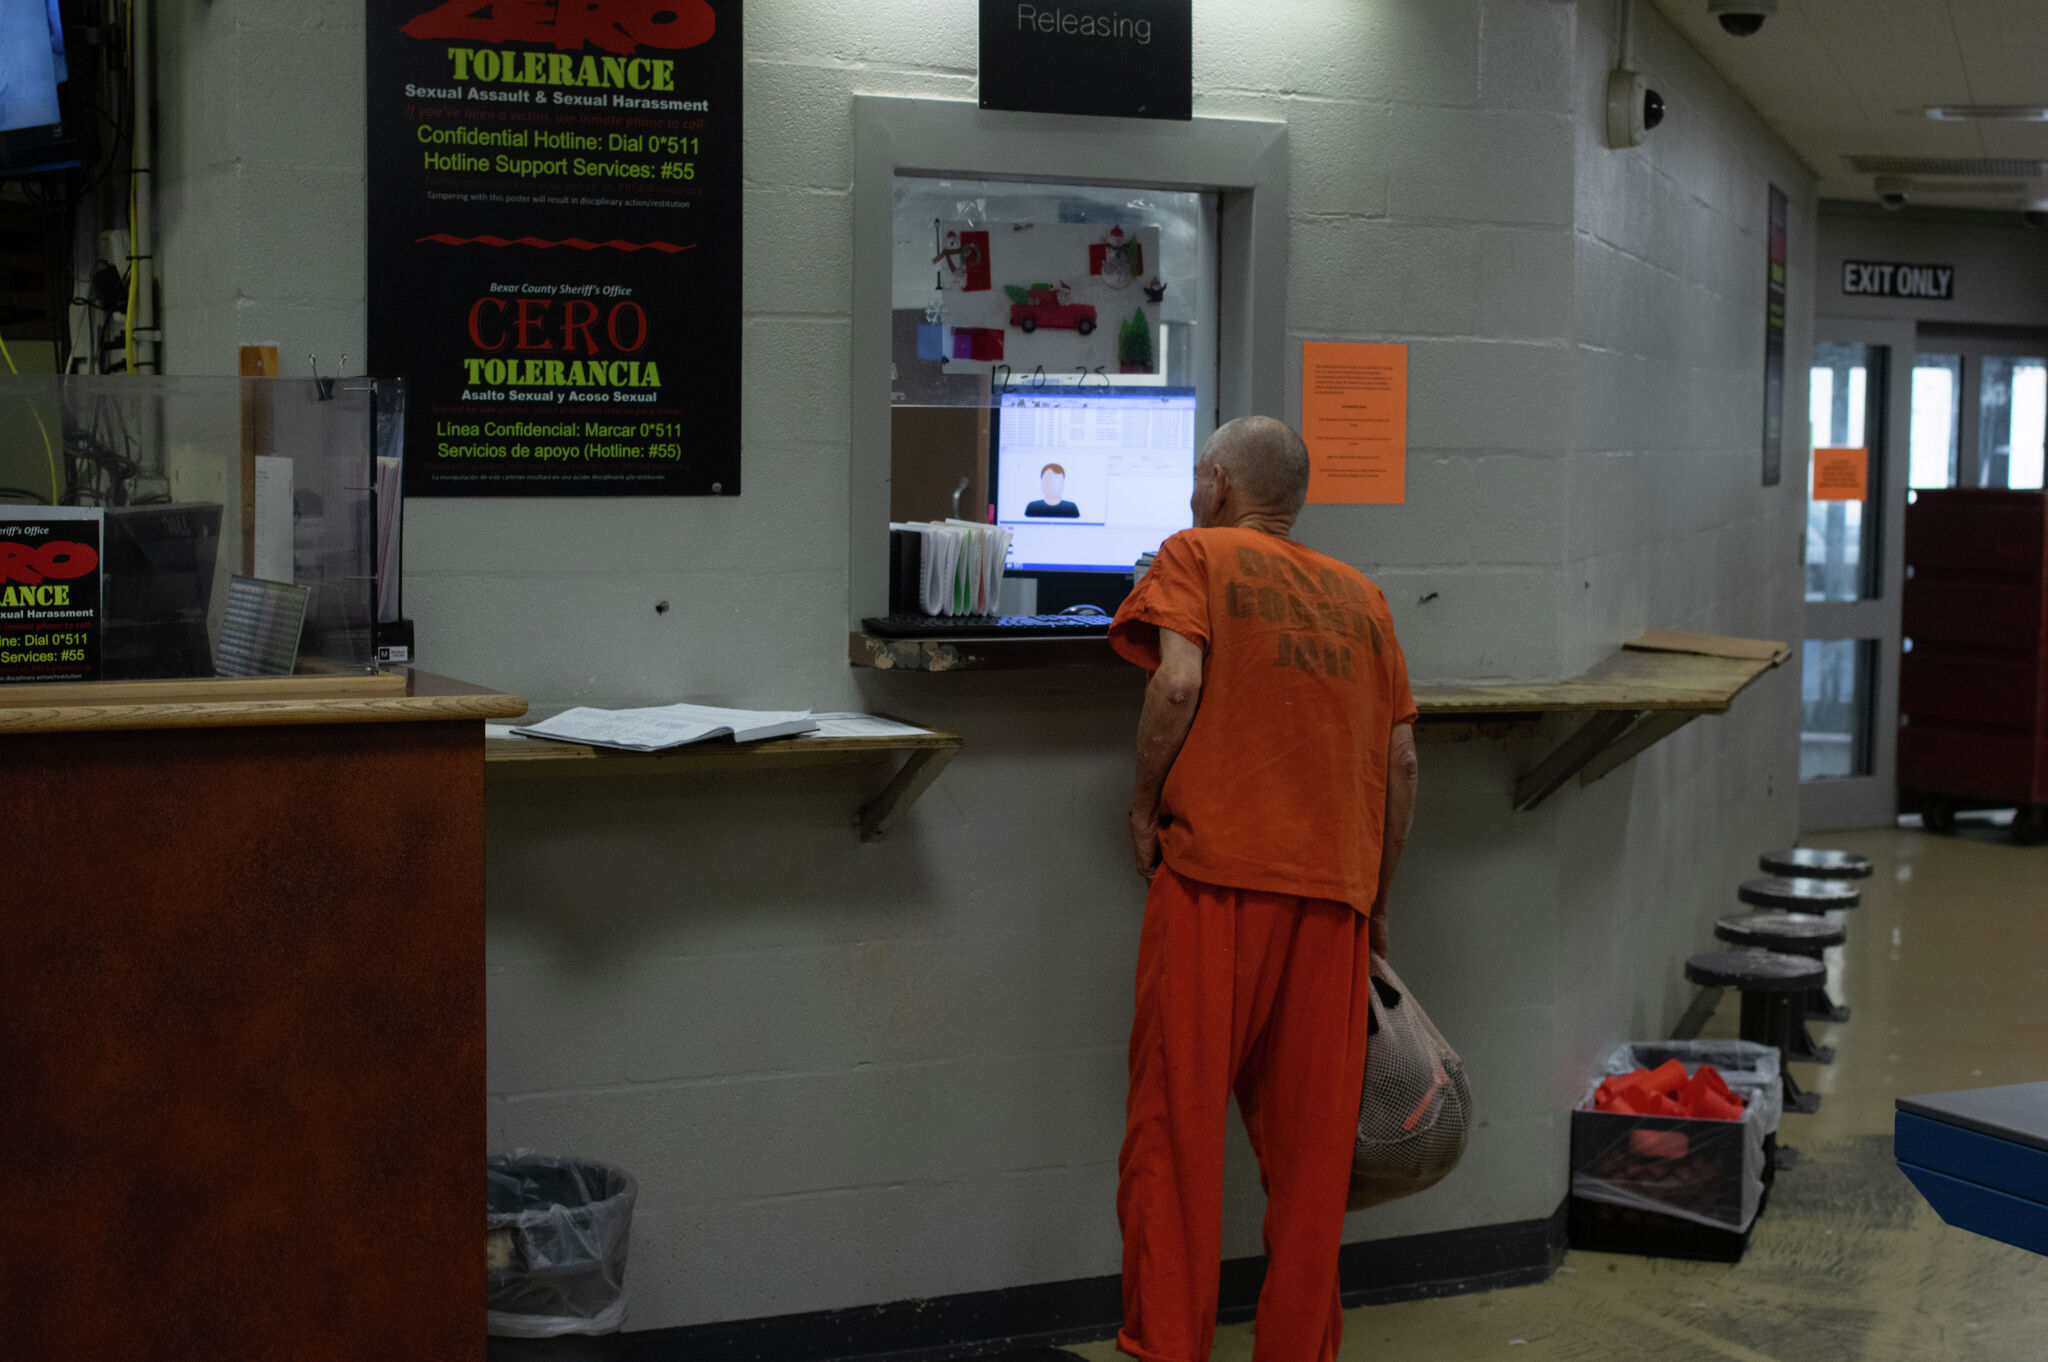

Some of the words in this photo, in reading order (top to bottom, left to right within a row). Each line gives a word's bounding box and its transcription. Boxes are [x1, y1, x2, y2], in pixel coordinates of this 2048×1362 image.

[398, 0, 717, 54] ZERO
[1018, 4, 1151, 44] Releasing
[448, 47, 675, 91] TOLERANCE
[404, 83, 462, 99] Sexual
[467, 87, 530, 103] Assault
[535, 90, 548, 103] &
[552, 91, 608, 107] Sexual
[612, 95, 710, 112] Harassment
[417, 124, 528, 147] Confidential
[534, 129, 603, 151] Hotline:
[608, 133, 644, 152] Dial
[424, 151, 490, 171] Hotline
[495, 154, 568, 178] Support
[573, 157, 656, 179] Services:
[660, 161, 696, 181] #55
[427, 190, 469, 202] Tampering
[470, 192, 488, 202] with
[490, 193, 504, 202] this
[506, 194, 530, 204] poster
[532, 194, 547, 203] will
[548, 195, 569, 204] result
[571, 196, 579, 205] in
[580, 196, 623, 208] disciplinary
[624, 198, 690, 209] action/restitution
[489, 282, 520, 294] Bexar
[521, 283, 557, 296] County
[560, 283, 601, 297] Sheriff's
[602, 284, 632, 297] Office
[1845, 263, 1895, 294] EXIT
[1896, 265, 1951, 297] ONLY
[467, 296, 650, 357] CERO
[463, 358, 662, 387] TOLERANCIA
[461, 389, 505, 401] Asalto
[508, 390, 554, 402] Sexual
[557, 392, 565, 404] y
[568, 390, 610, 402] Acoso
[613, 391, 657, 403] Sexual
[437, 421, 481, 437] Línea
[484, 421, 581, 438] Confidencial:
[585, 422, 637, 437] Marcar
[437, 442, 507, 458] Servicios
[511, 442, 530, 458] de
[534, 446, 580, 461] apoyo
[584, 443, 645, 461] (Hotline:
[648, 443, 683, 461] #55)
[25, 526, 50, 537] Office
[0, 585, 70, 607] ANCE
[27, 608, 94, 619] Harassment
[25, 633, 49, 646] Dial
[1, 650, 58, 664] Services:
[61, 648, 85, 662] #55
